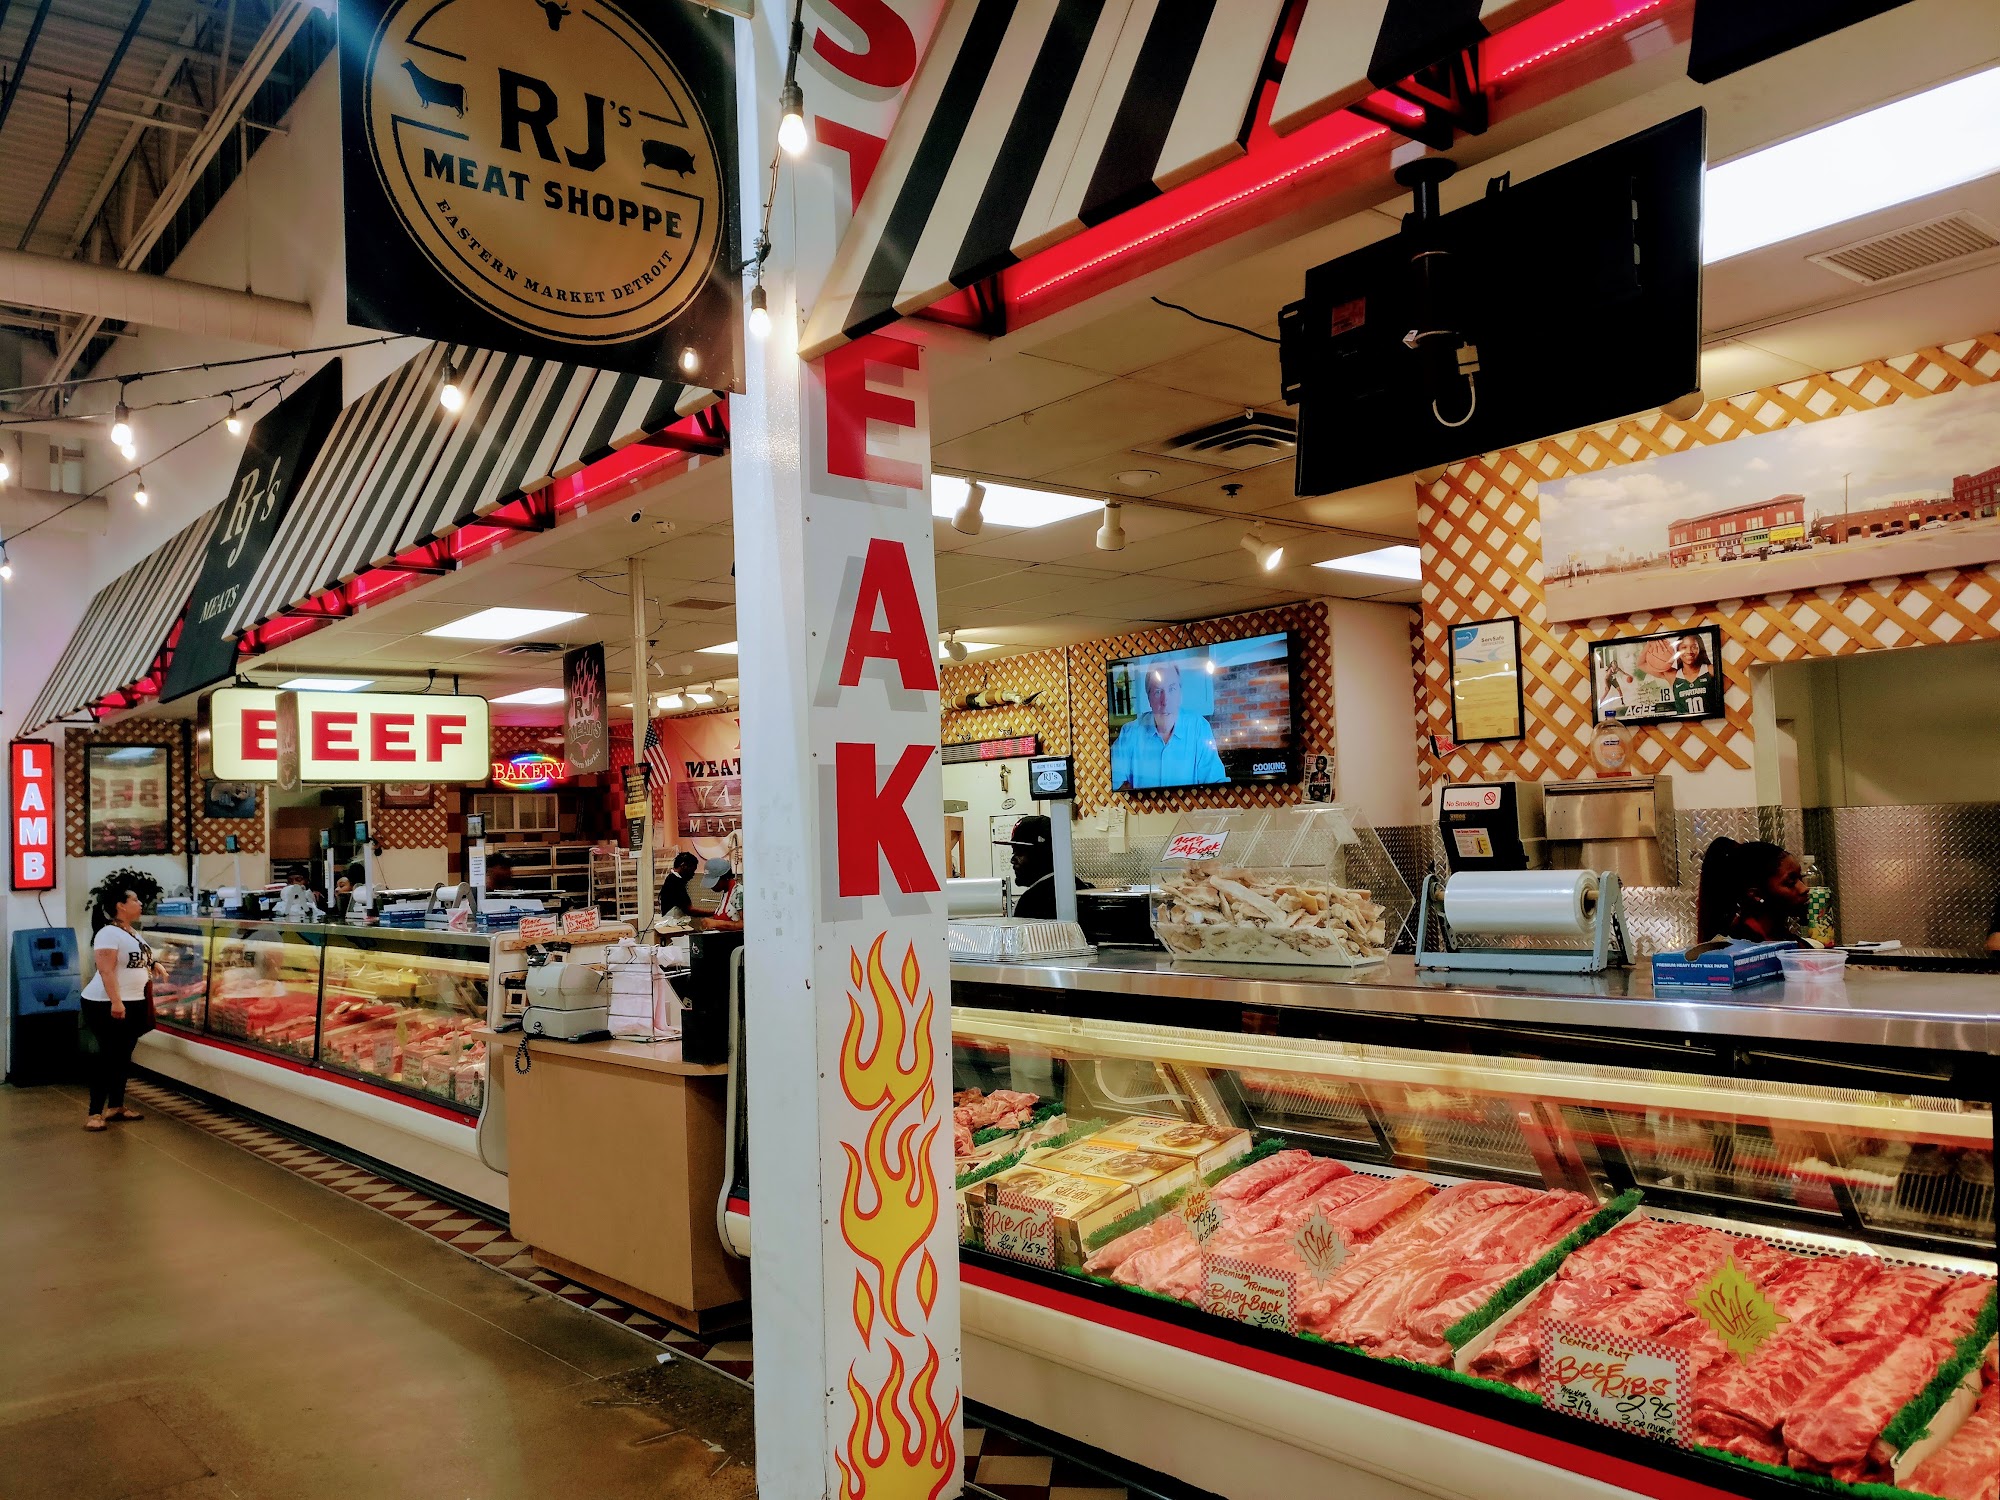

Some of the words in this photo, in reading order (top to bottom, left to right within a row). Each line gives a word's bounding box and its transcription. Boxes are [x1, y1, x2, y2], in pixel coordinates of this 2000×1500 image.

[498, 67, 632, 173] RJ'S
[423, 147, 530, 202] MEAT
[544, 180, 683, 239] SHOPPE
[435, 199, 518, 282] EASTERN
[524, 277, 605, 304] MARKET
[611, 249, 674, 302] DETROIT
[198, 583, 240, 624] MEATS
[1660, 688, 1670, 701] 18
[1679, 687, 1706, 698] SPARTANS
[574, 692, 594, 719] RJ
[1624, 705, 1656, 716] AGEE
[1685, 696, 1704, 714] 10
[241, 709, 467, 763] BEEF
[568, 720, 602, 745] MEATS
[492, 762, 565, 781] BAKERY
[1252, 761, 1286, 772] COOKING
[1455, 800, 1480, 808] Smoking
[18, 749, 48, 881] LAMB
[1187, 1190, 1206, 1208] CASE
[1184, 1200, 1211, 1222] PRICE
[1647, 1419, 1676, 1436] MORE
